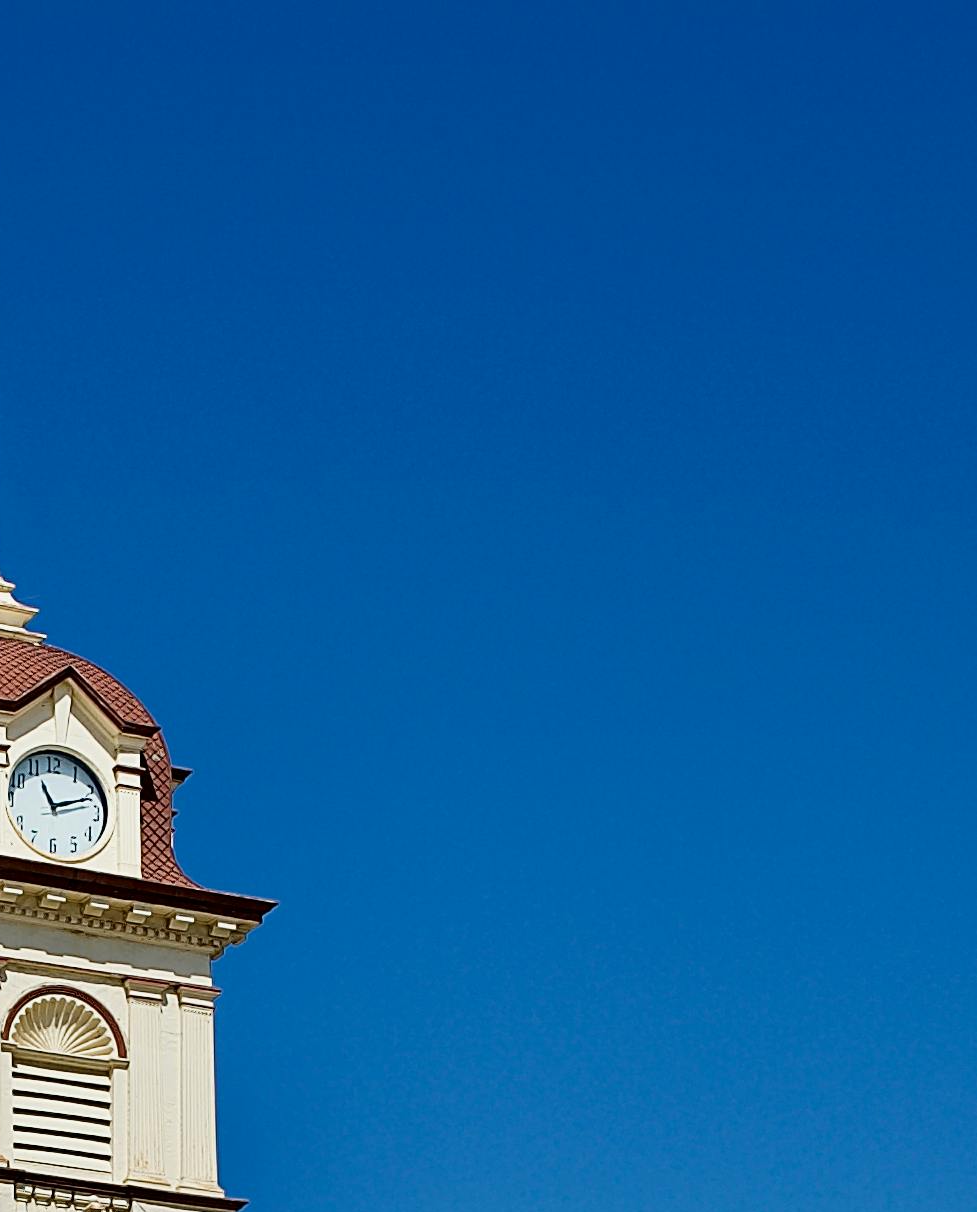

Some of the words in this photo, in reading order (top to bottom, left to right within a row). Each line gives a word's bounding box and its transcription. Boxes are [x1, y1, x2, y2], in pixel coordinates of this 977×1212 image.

[29, 758, 40, 776] 11
[47, 756, 61, 774] 12
[49, 838, 57, 854] 6
